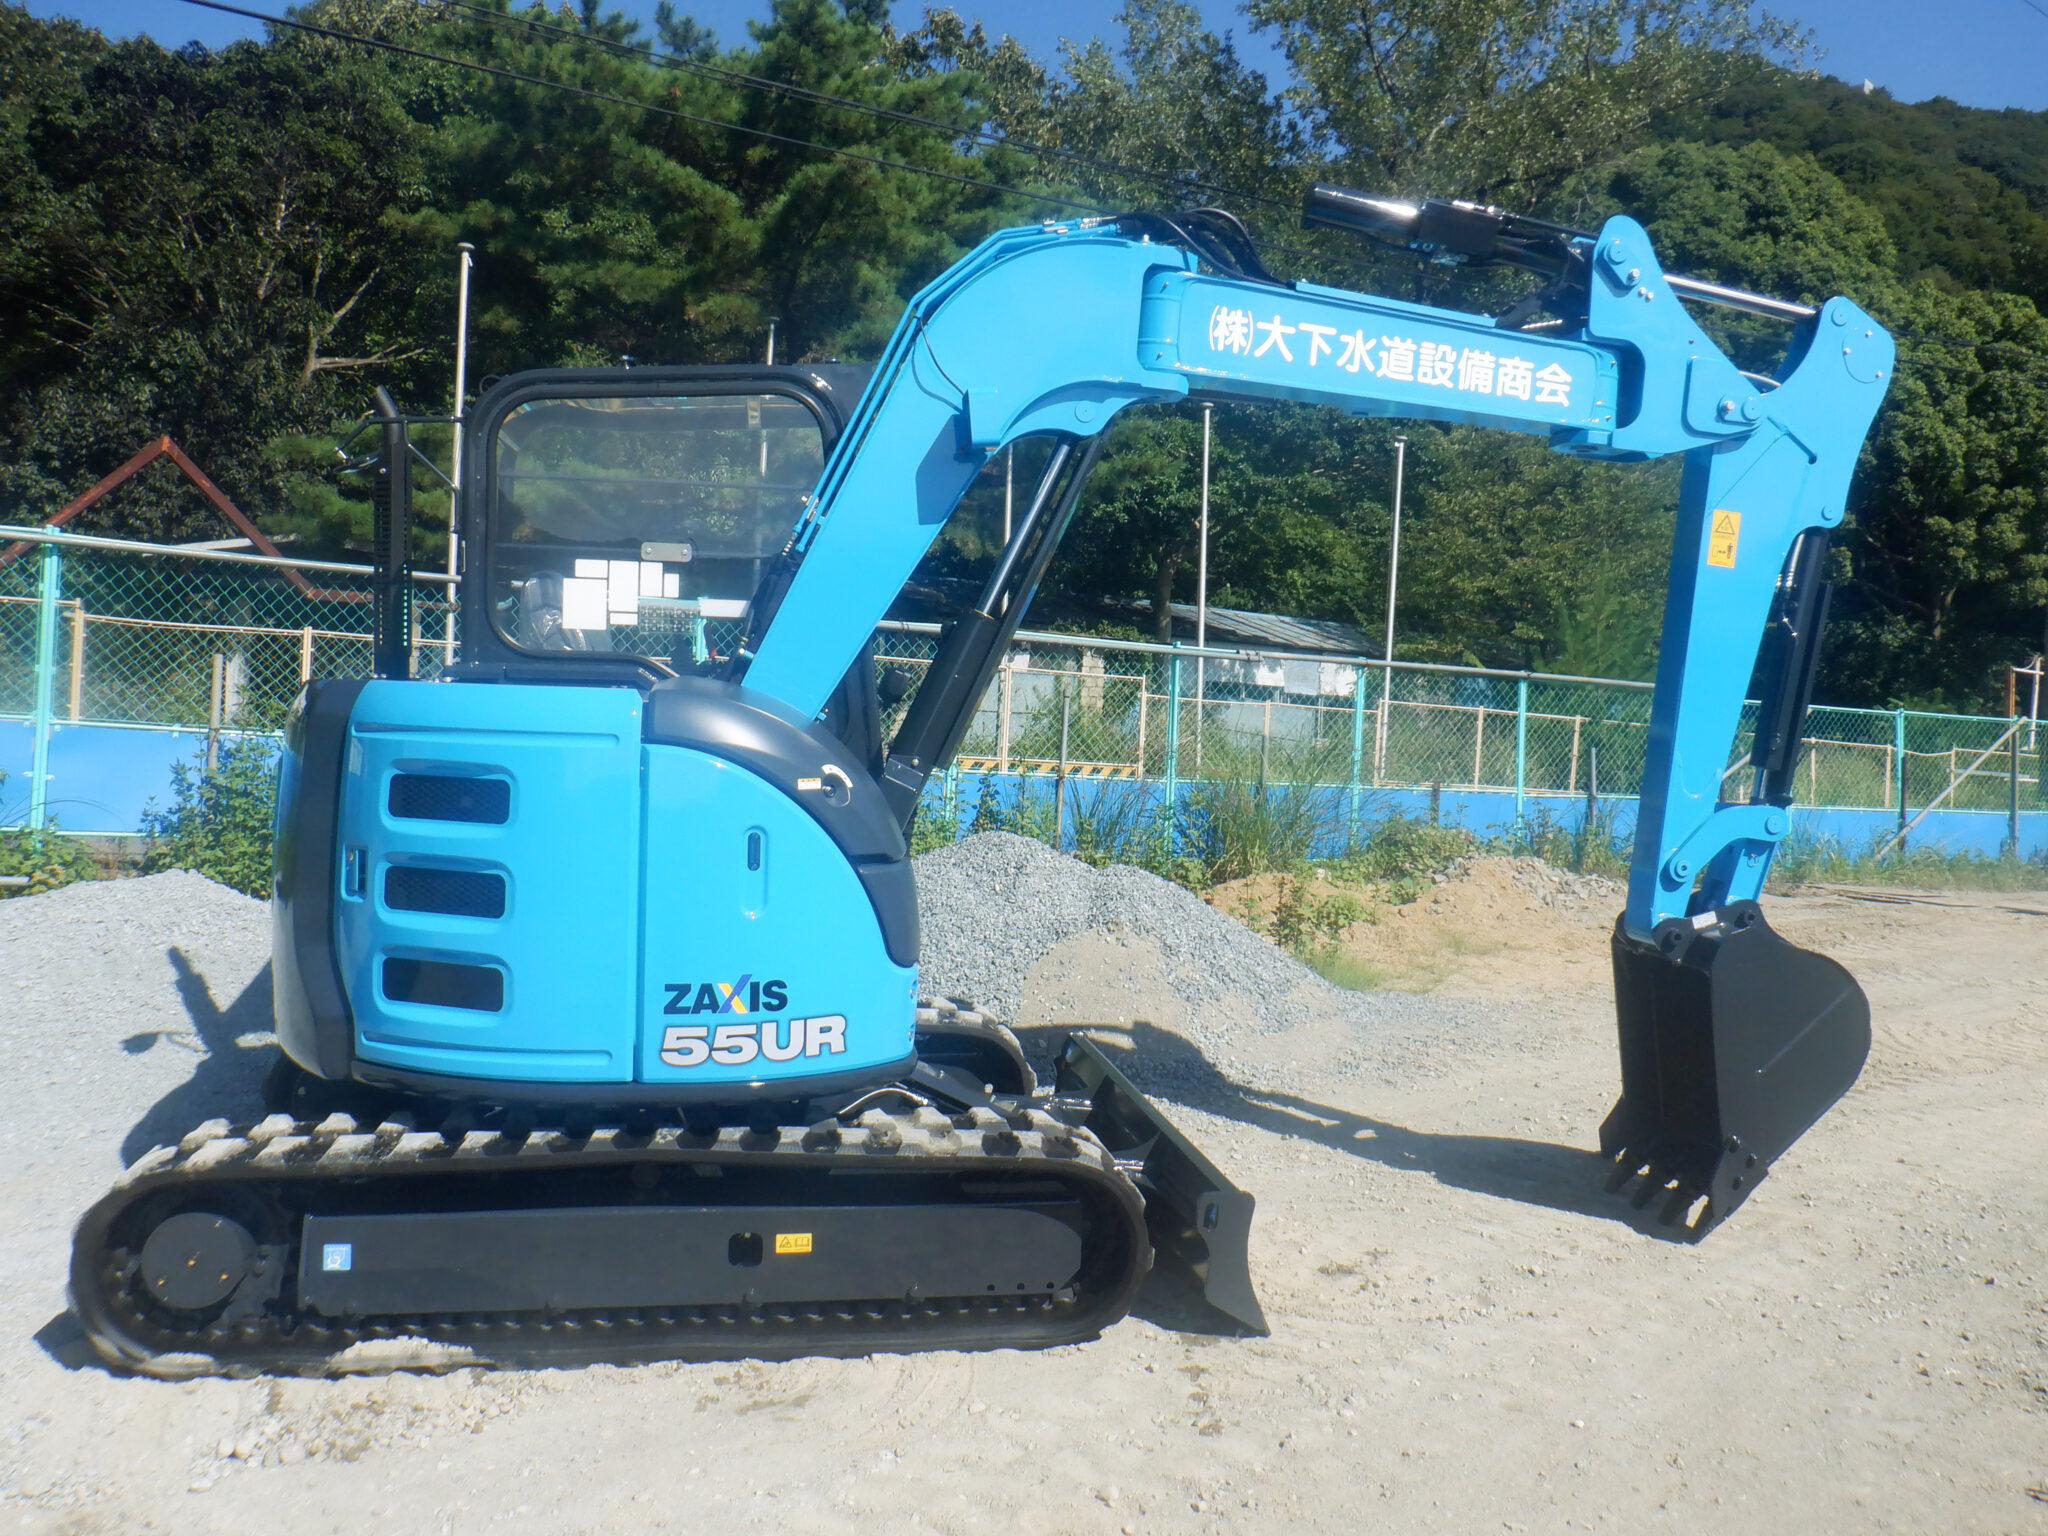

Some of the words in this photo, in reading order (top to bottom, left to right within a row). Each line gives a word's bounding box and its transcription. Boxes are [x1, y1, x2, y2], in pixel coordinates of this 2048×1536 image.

[1209, 305, 1573, 407] (株)大下水道設備商会
[663, 974, 788, 1014] ZAXIS
[660, 1014, 847, 1067] 55UR
